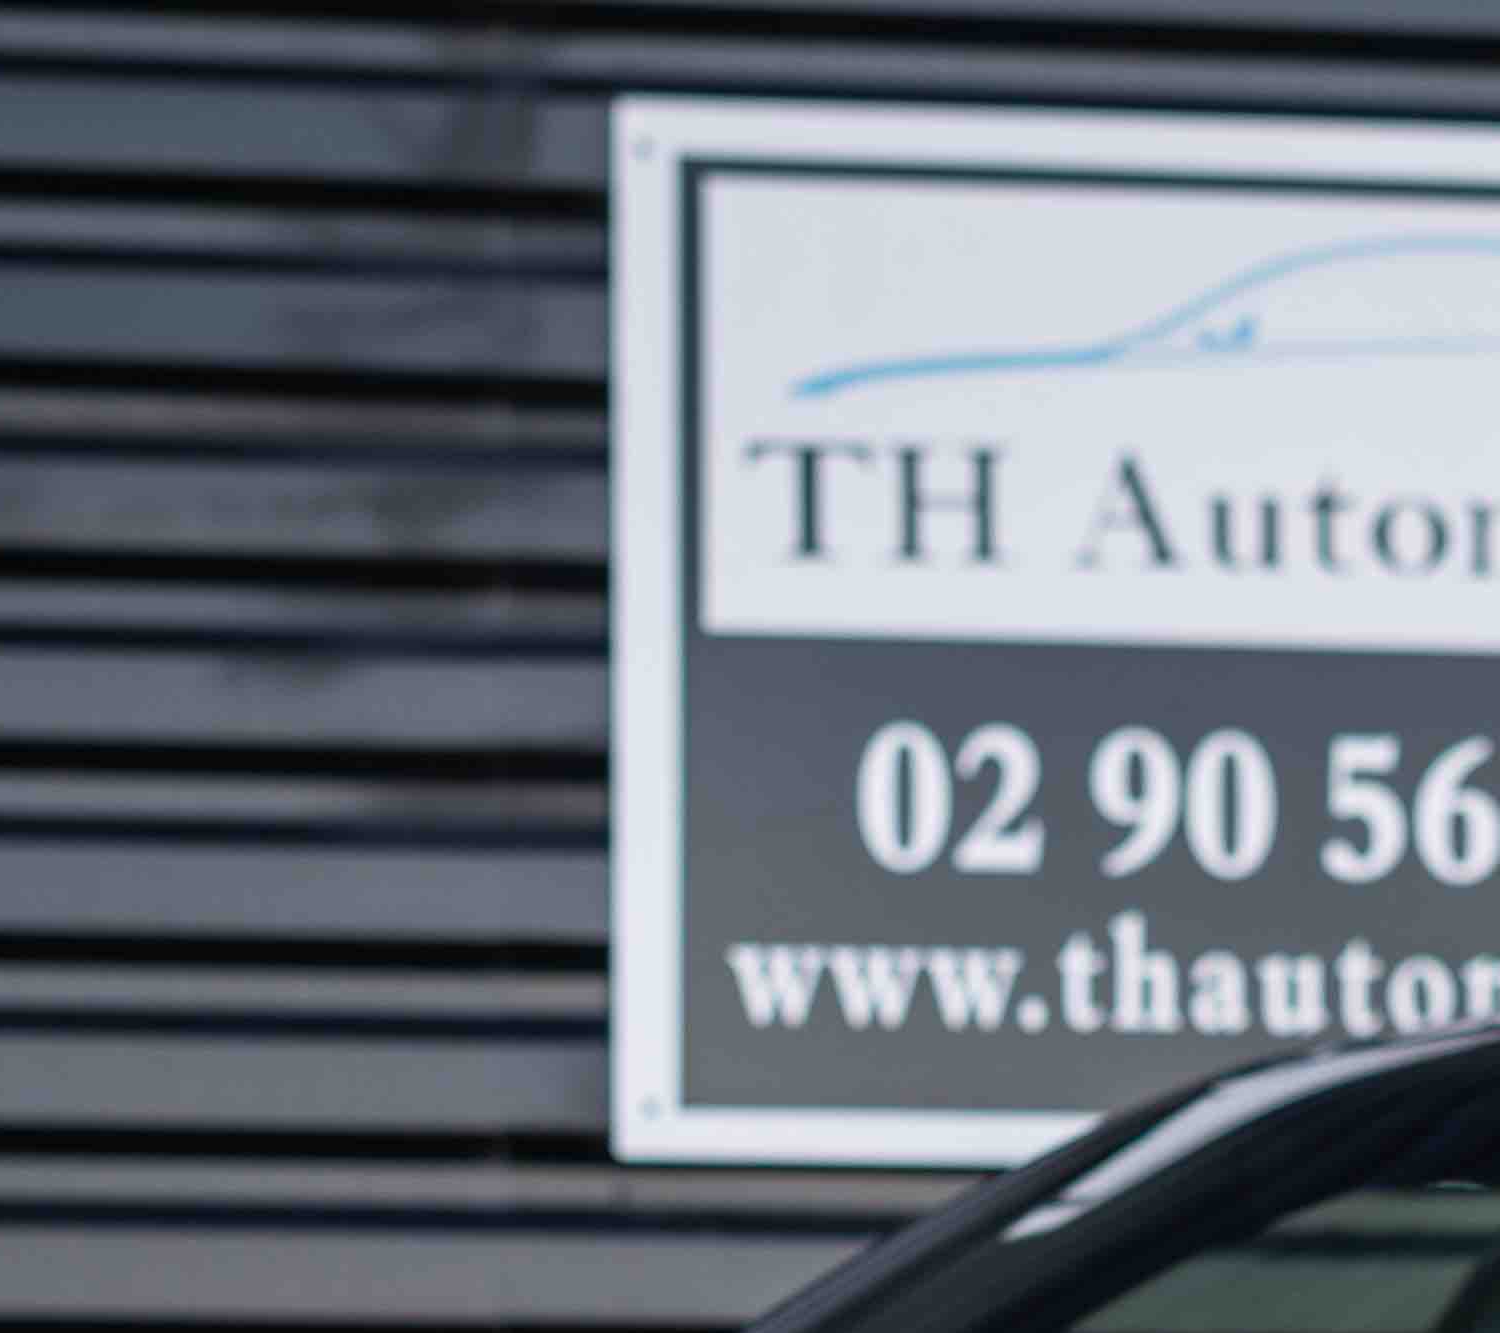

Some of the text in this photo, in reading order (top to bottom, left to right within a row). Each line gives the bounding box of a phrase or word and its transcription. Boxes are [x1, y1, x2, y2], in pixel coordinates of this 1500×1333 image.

[743, 440, 1011, 565] TH
[856, 720, 1046, 875] 02
[1088, 726, 1278, 880] 90
